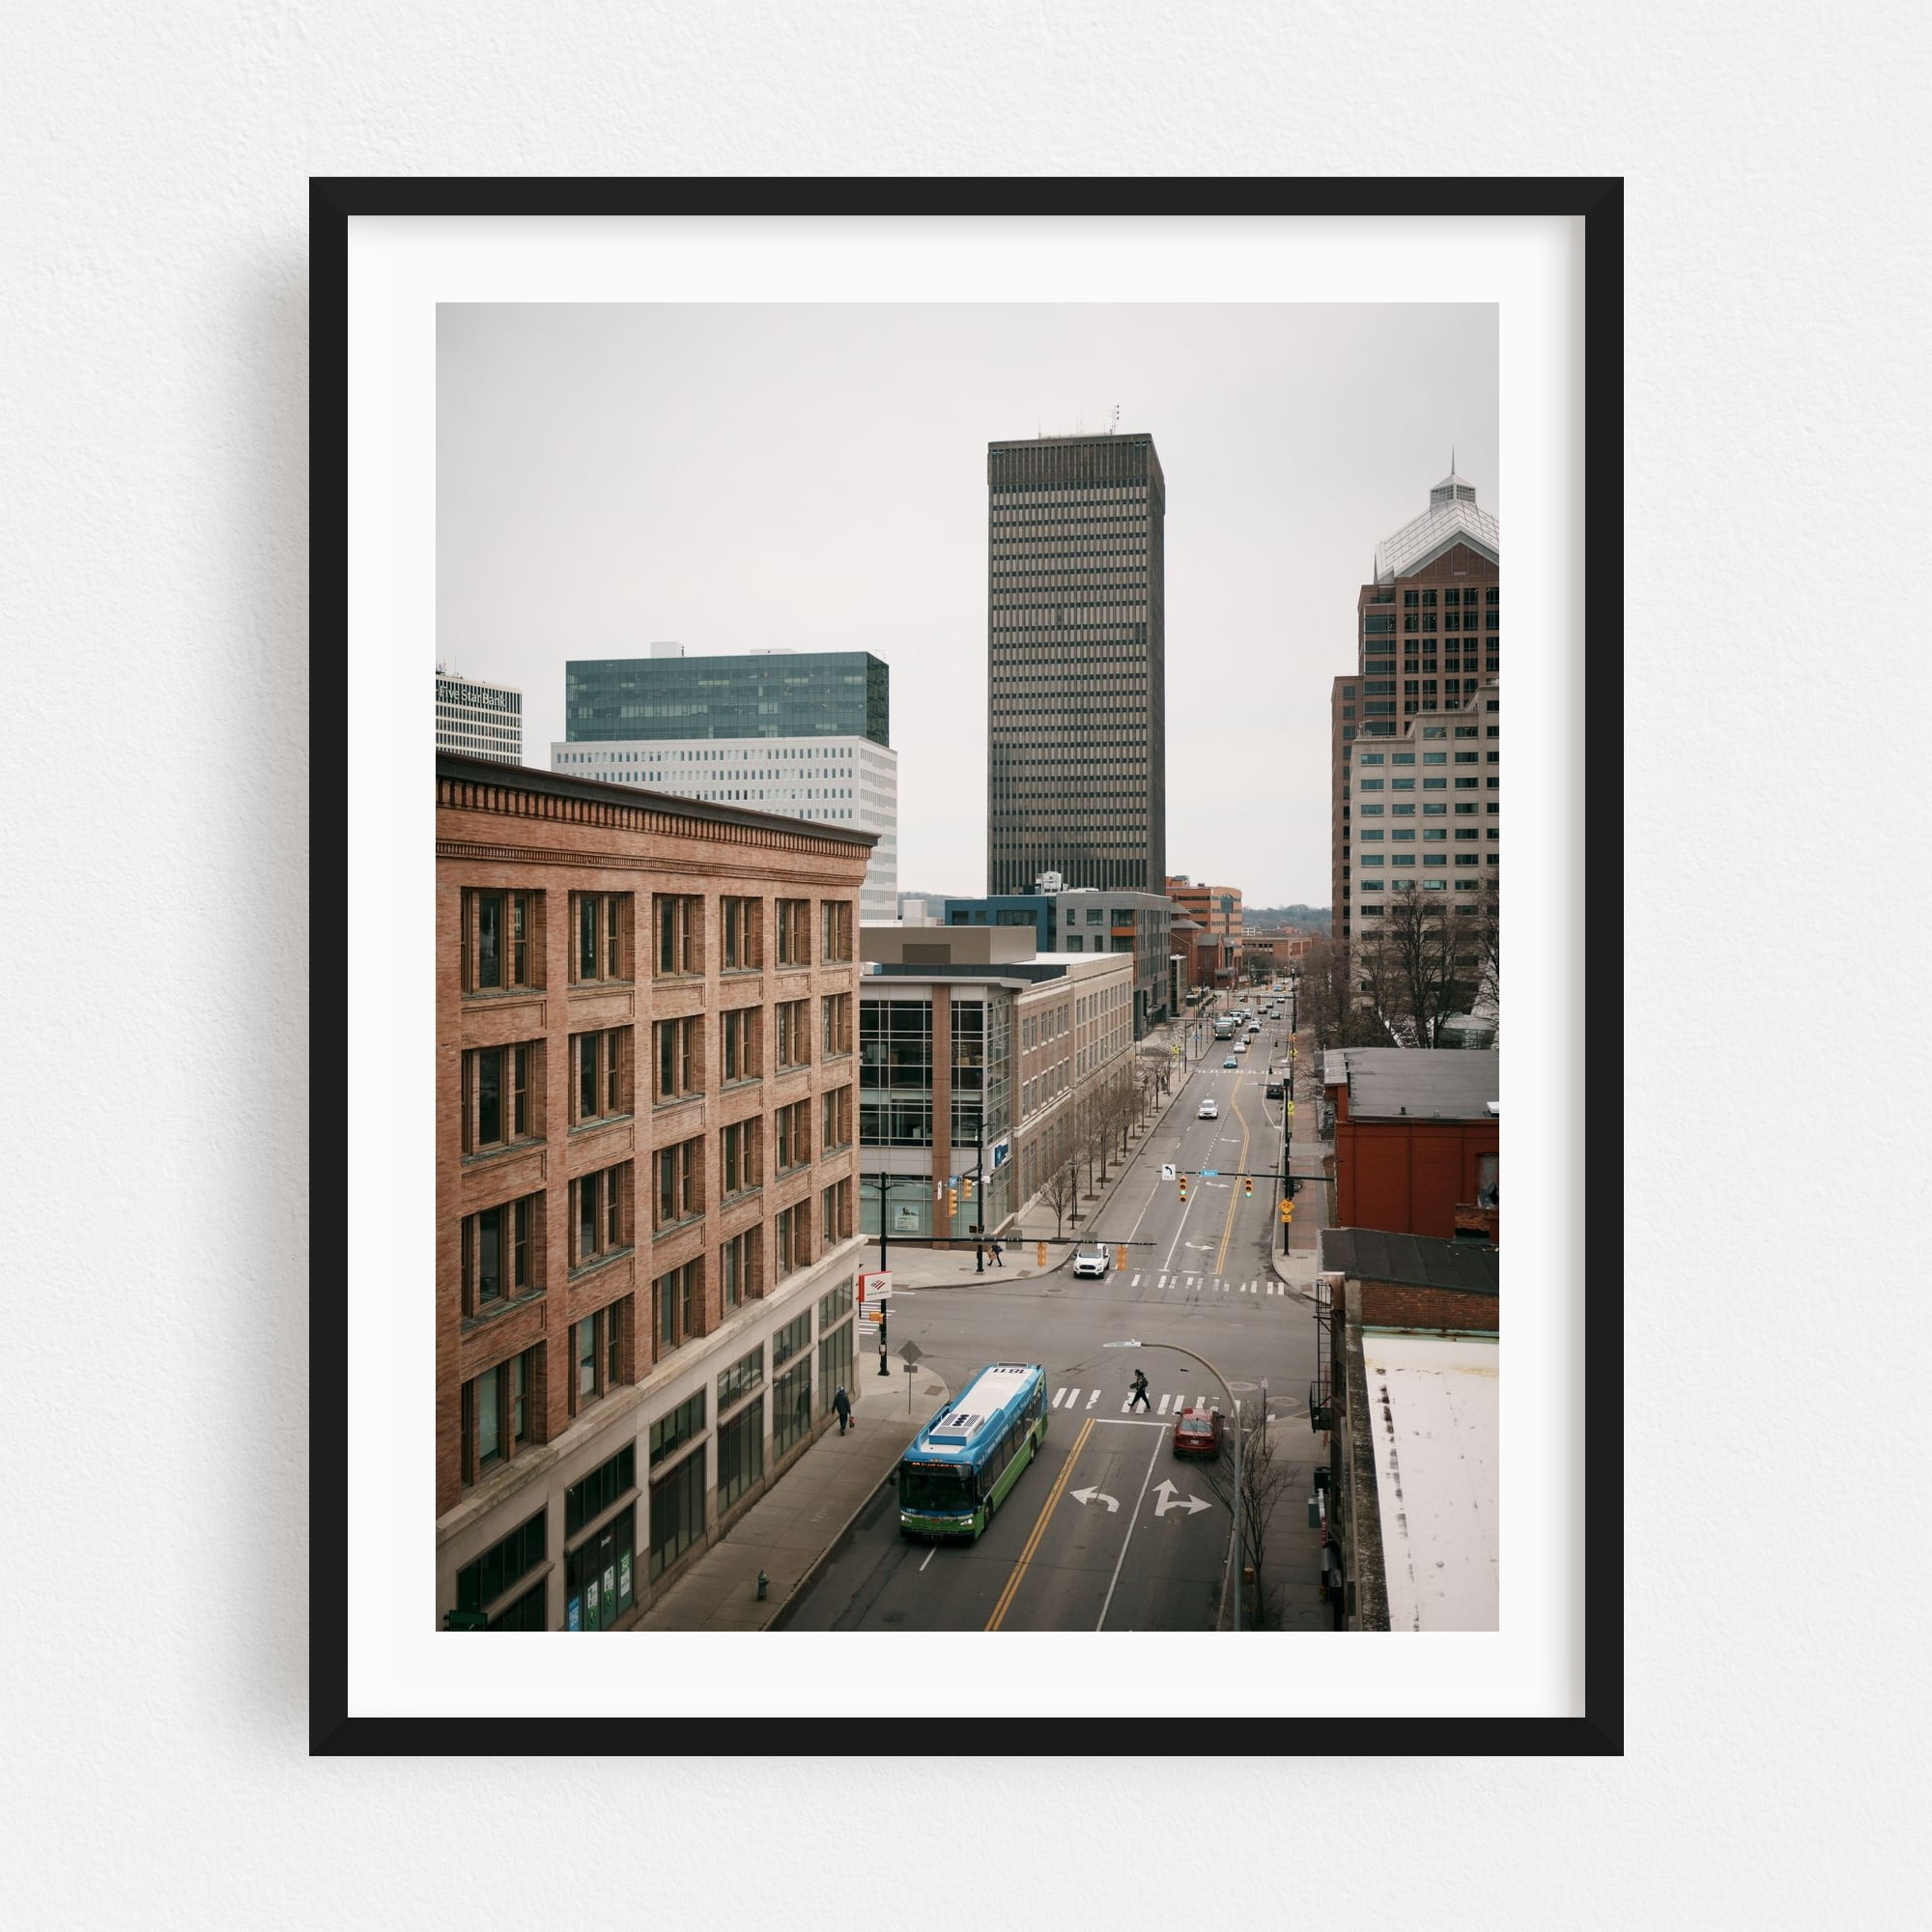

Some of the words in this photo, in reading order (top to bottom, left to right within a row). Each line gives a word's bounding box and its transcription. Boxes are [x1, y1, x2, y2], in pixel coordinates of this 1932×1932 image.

[440, 685, 459, 699] Five
[461, 690, 481, 703] Star
[483, 693, 506, 707] Bank
